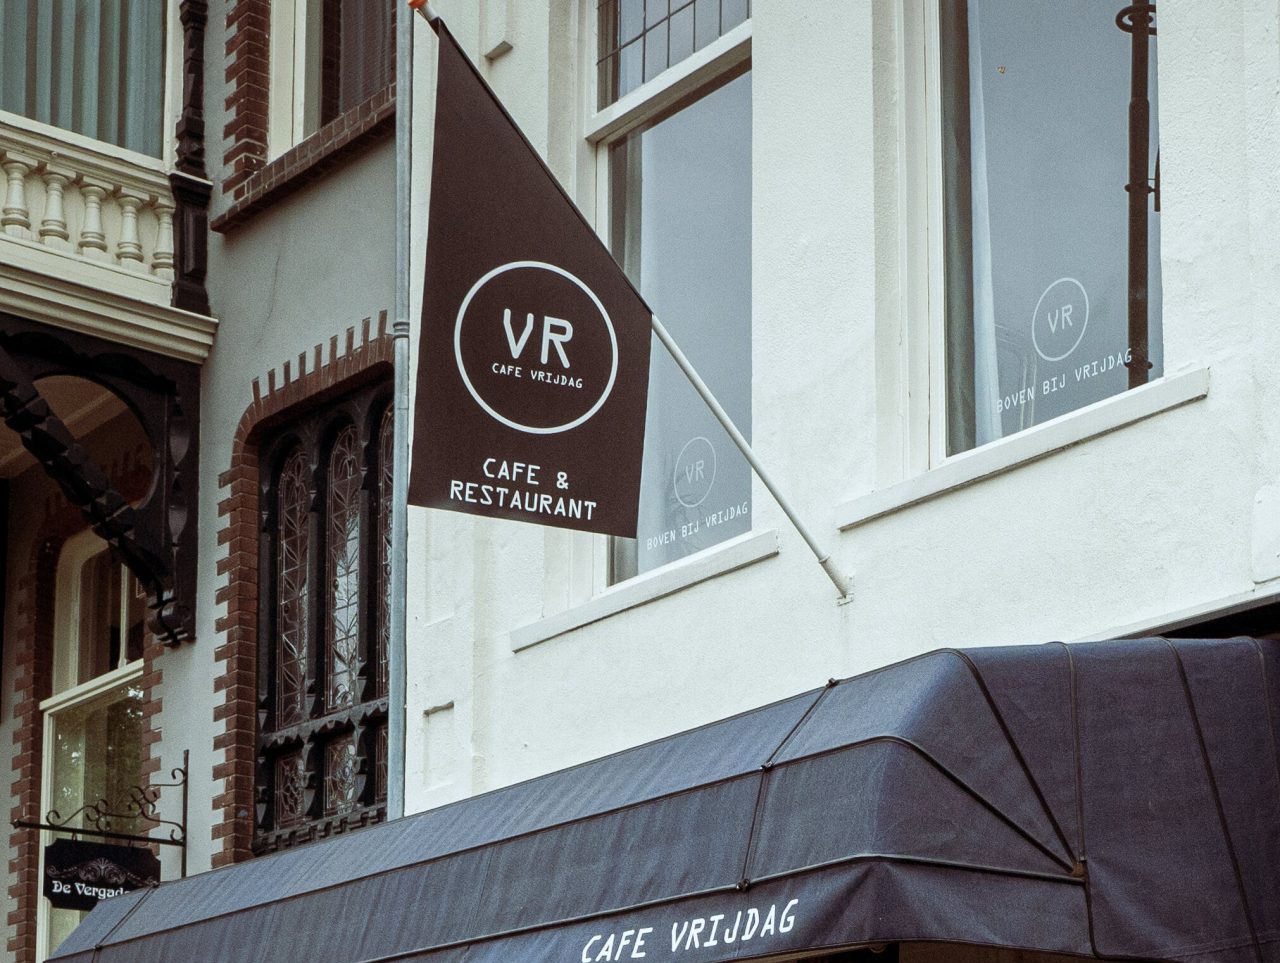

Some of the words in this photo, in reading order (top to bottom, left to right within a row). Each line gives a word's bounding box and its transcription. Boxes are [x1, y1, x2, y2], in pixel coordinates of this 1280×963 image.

[1048, 304, 1073, 334] VR
[503, 308, 574, 369] VR
[491, 363, 522, 378] CAFE
[531, 370, 583, 389] VRIJDAG
[997, 387, 1035, 413] BOVEN
[1042, 374, 1066, 395] BIJ
[1075, 348, 1132, 382] VRIJDAG
[483, 458, 541, 485] CAFE
[556, 471, 569, 490] &
[685, 460, 704, 484] VR
[450, 479, 597, 521] RESTAURANT
[646, 530, 676, 551] BOVEN
[681, 520, 699, 538] BIJ
[705, 501, 748, 528] VRIJDAG
[52, 880, 71, 894] De
[74, 882, 130, 899] Vergad
[581, 927, 653, 963] CAFE
[671, 899, 798, 952] VRIJDAG
